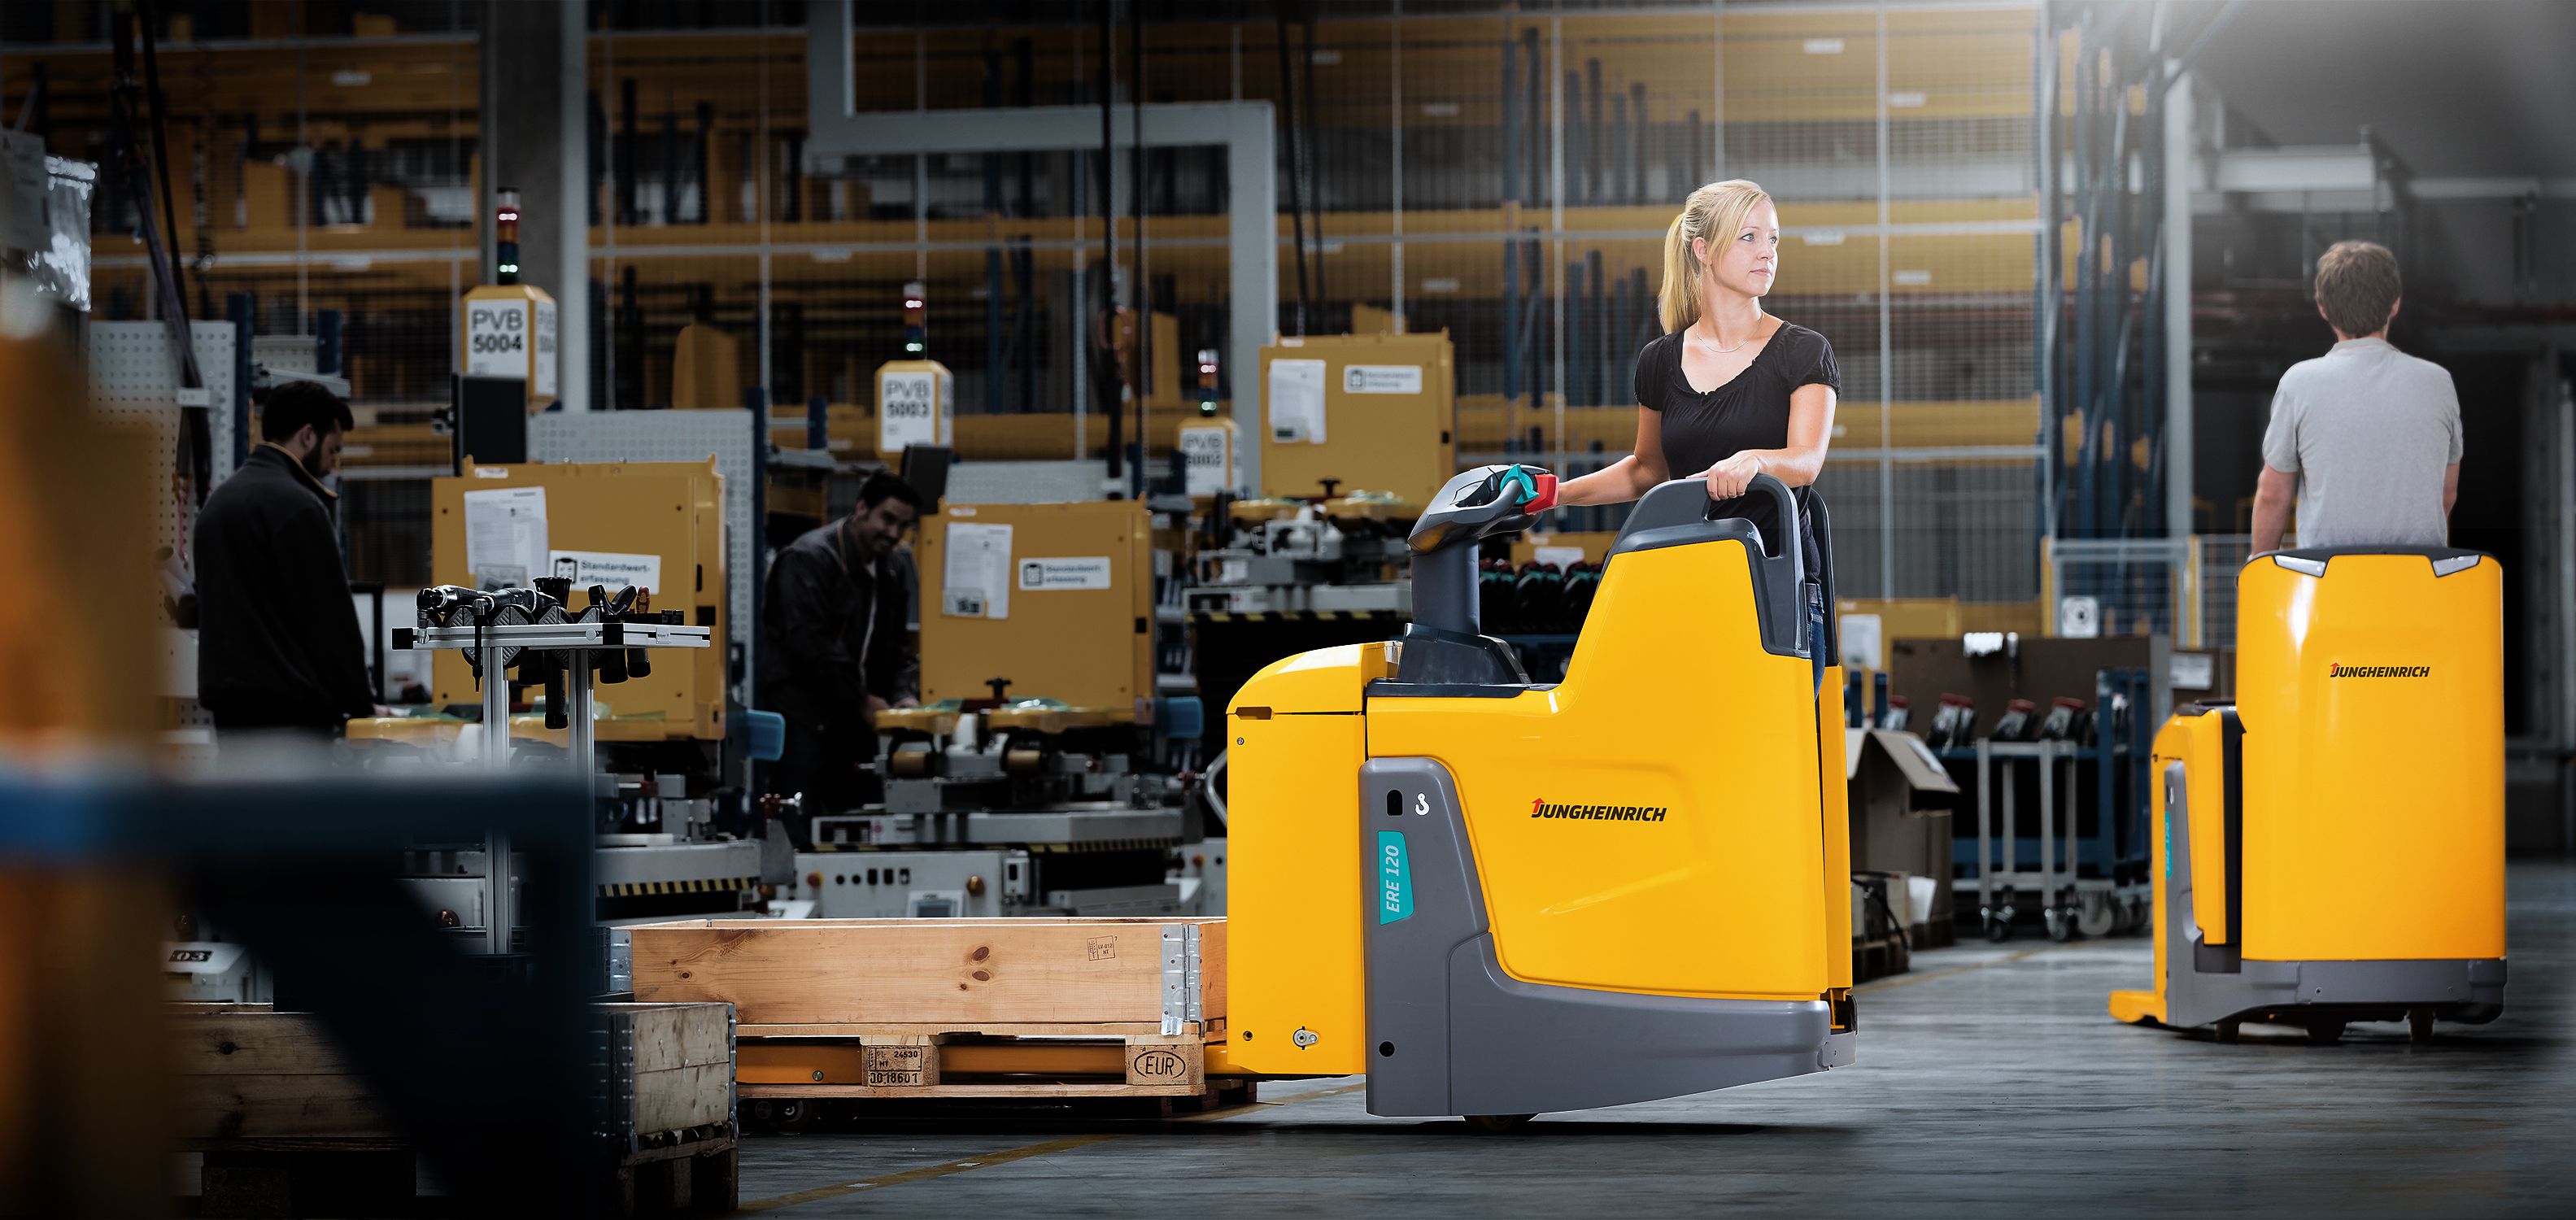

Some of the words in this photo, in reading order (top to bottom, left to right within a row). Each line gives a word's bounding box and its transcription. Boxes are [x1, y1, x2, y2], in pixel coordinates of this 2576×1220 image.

[473, 308, 523, 331] PVB
[473, 333, 522, 354] 5004
[885, 380, 930, 399] PVB
[2330, 665, 2430, 678] JUNGHEINRICH
[1531, 803, 1667, 822] JUNGHEINRICH
[1385, 844, 1399, 876] 120
[1385, 879, 1400, 913] ERE
[894, 1050, 918, 1058] 24530
[1145, 1056, 1175, 1076] EUR
